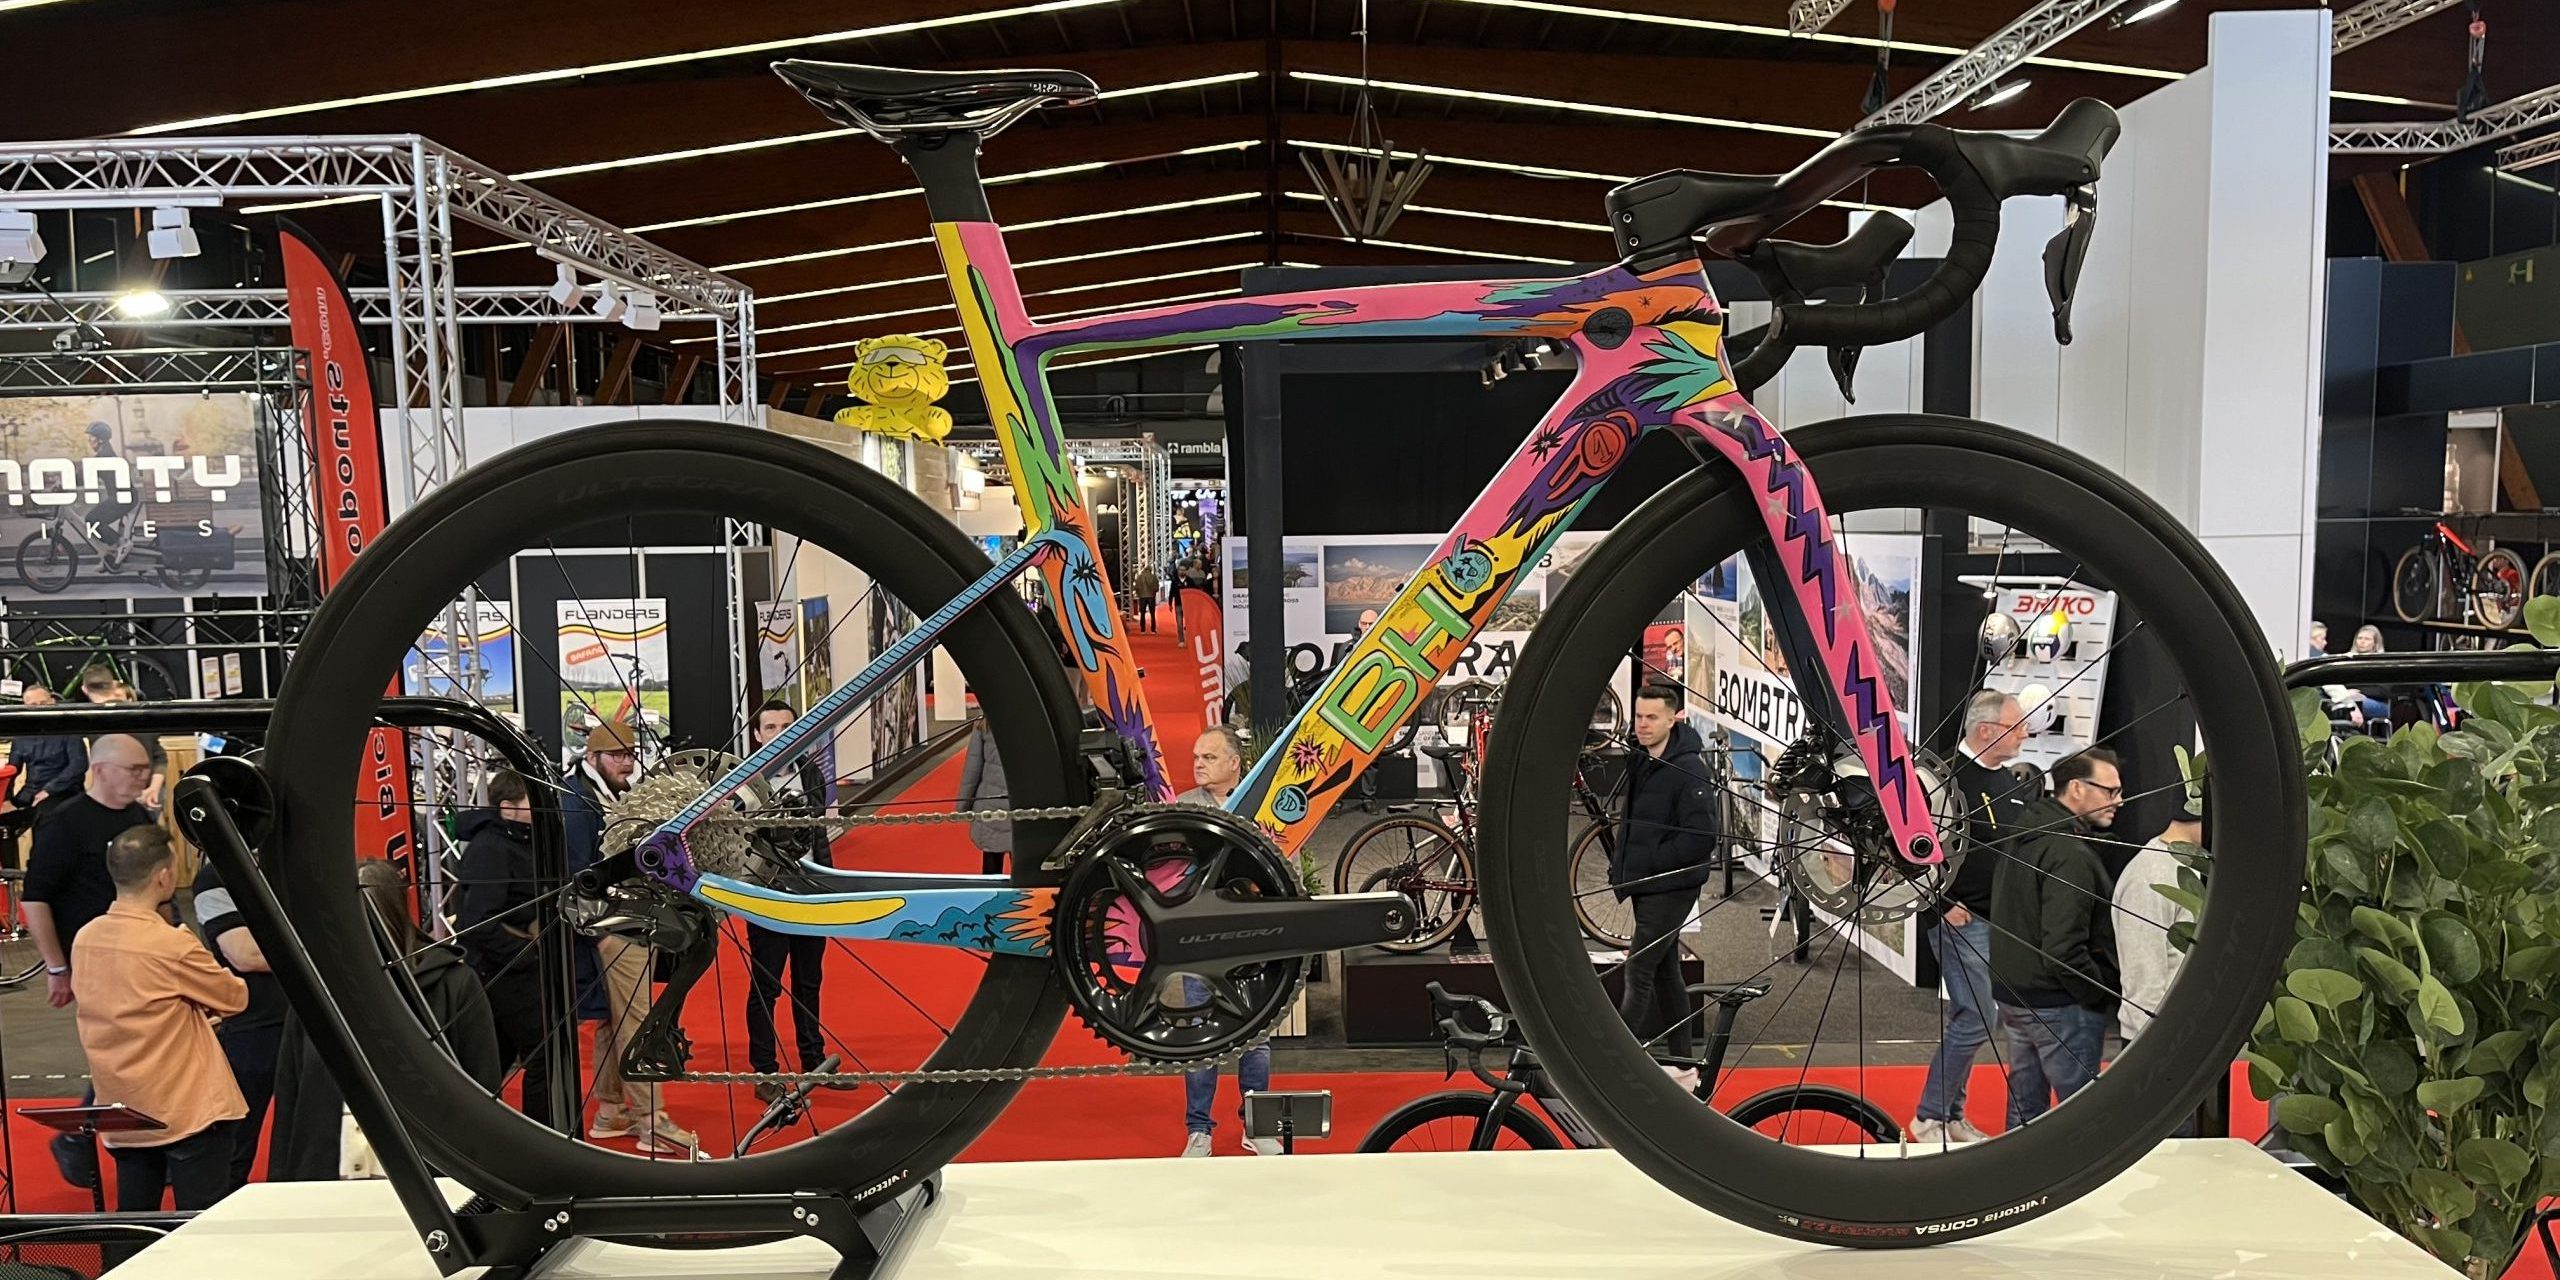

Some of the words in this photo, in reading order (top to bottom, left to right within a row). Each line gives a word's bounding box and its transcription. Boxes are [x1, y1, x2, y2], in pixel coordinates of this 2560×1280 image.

[1181, 442, 1221, 453] rambla
[2012, 595, 2095, 615] BRIKO
[1316, 583, 1476, 756] BH
[1178, 926, 1285, 944] ULTEGRA
[854, 1174, 901, 1202] vittori
[1914, 1218, 1978, 1235] CORSA
